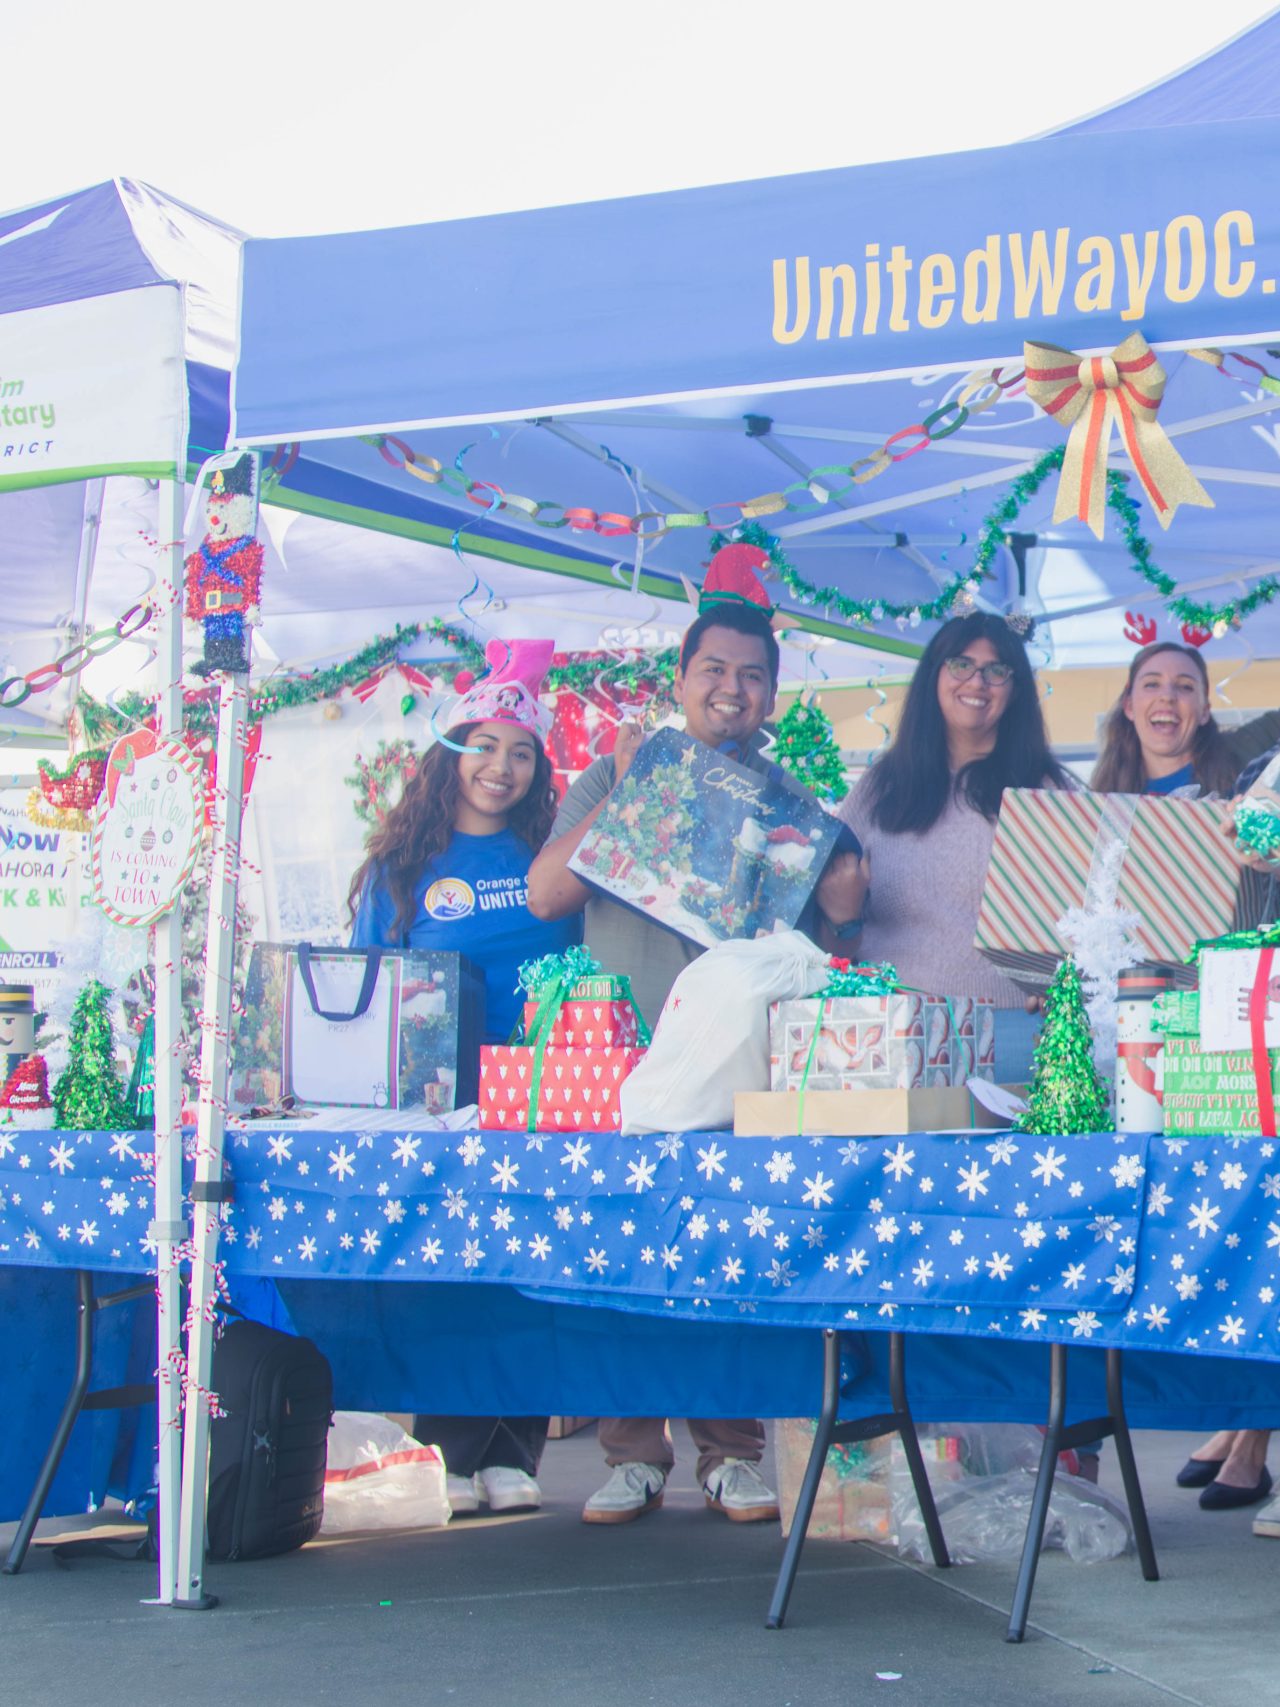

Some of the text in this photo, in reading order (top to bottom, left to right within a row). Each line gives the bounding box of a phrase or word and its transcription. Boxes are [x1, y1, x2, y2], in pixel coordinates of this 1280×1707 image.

[702, 767, 776, 815] Christmas
[118, 791, 155, 824] Santa
[110, 849, 177, 868] IS COMING
[133, 867, 151, 885] TO
[476, 877, 521, 891] Orange
[114, 885, 161, 906] TOWN
[0, 953, 50, 968] NROLL
